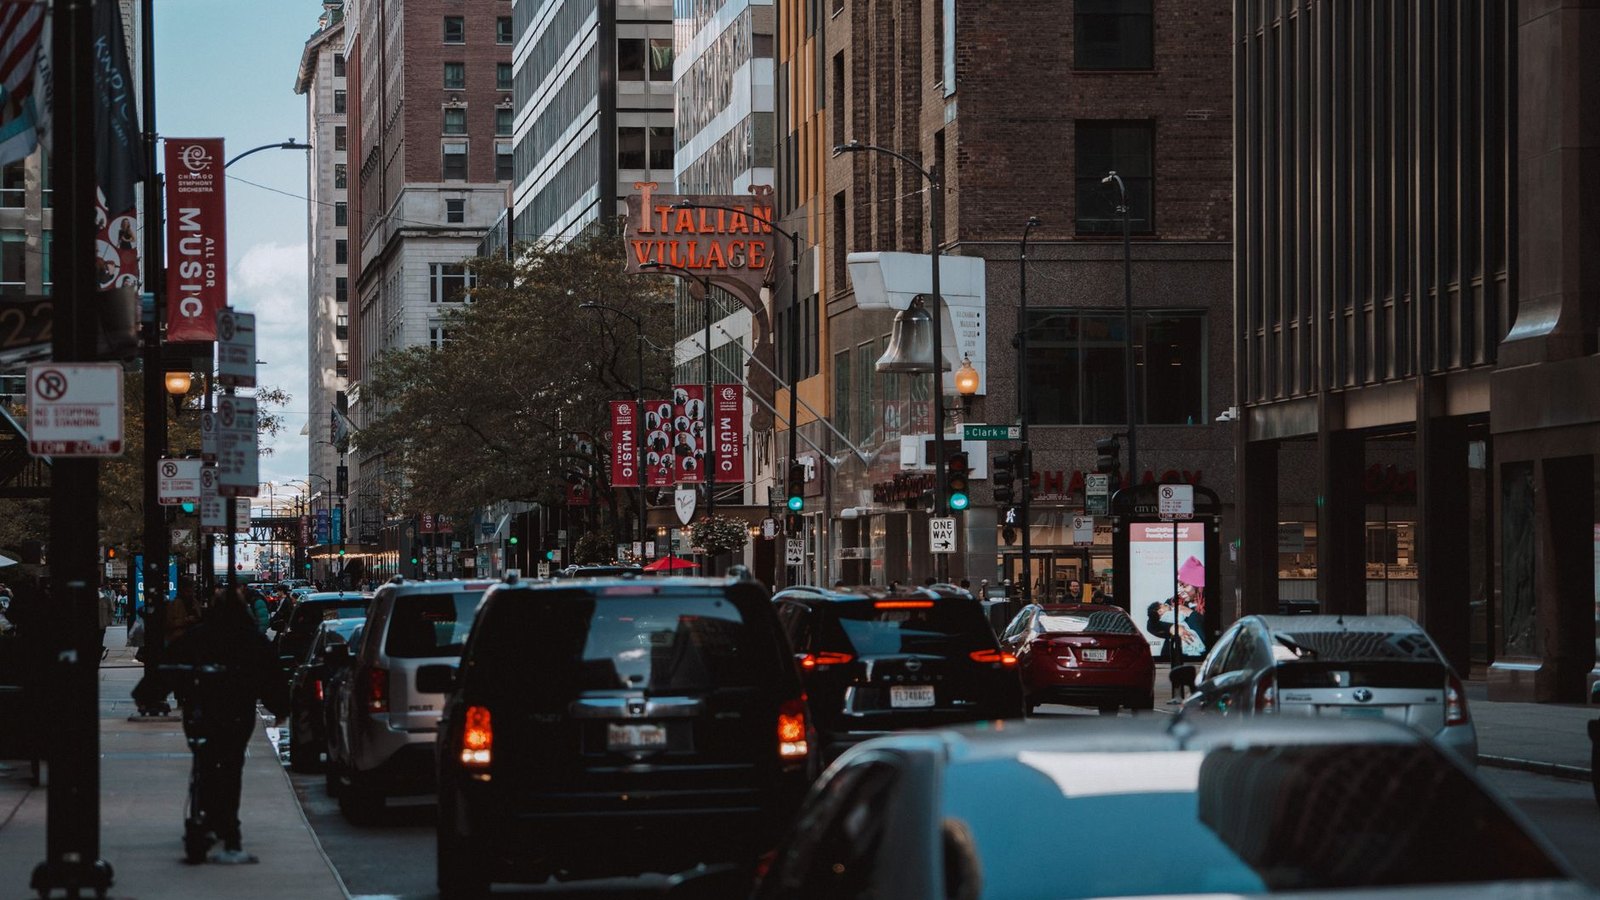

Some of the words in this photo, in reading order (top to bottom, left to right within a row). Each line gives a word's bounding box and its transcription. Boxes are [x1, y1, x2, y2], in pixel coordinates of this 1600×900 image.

[634, 182, 773, 235] ITALIAN
[205, 237, 214, 258] ALL
[631, 240, 766, 270] VILLAGE
[178, 207, 203, 318] MUSIC
[206, 263, 215, 287] FOR
[54, 407, 100, 416] STOPPING
[54, 418, 100, 427] STANDING
[972, 428, 998, 437] Clark
[37, 442, 66, 453] TOW
[622, 430, 633, 477] MUSIC
[721, 417, 732, 471] MUSIC
[933, 521, 952, 529] ONE
[933, 530, 953, 539] WAY
